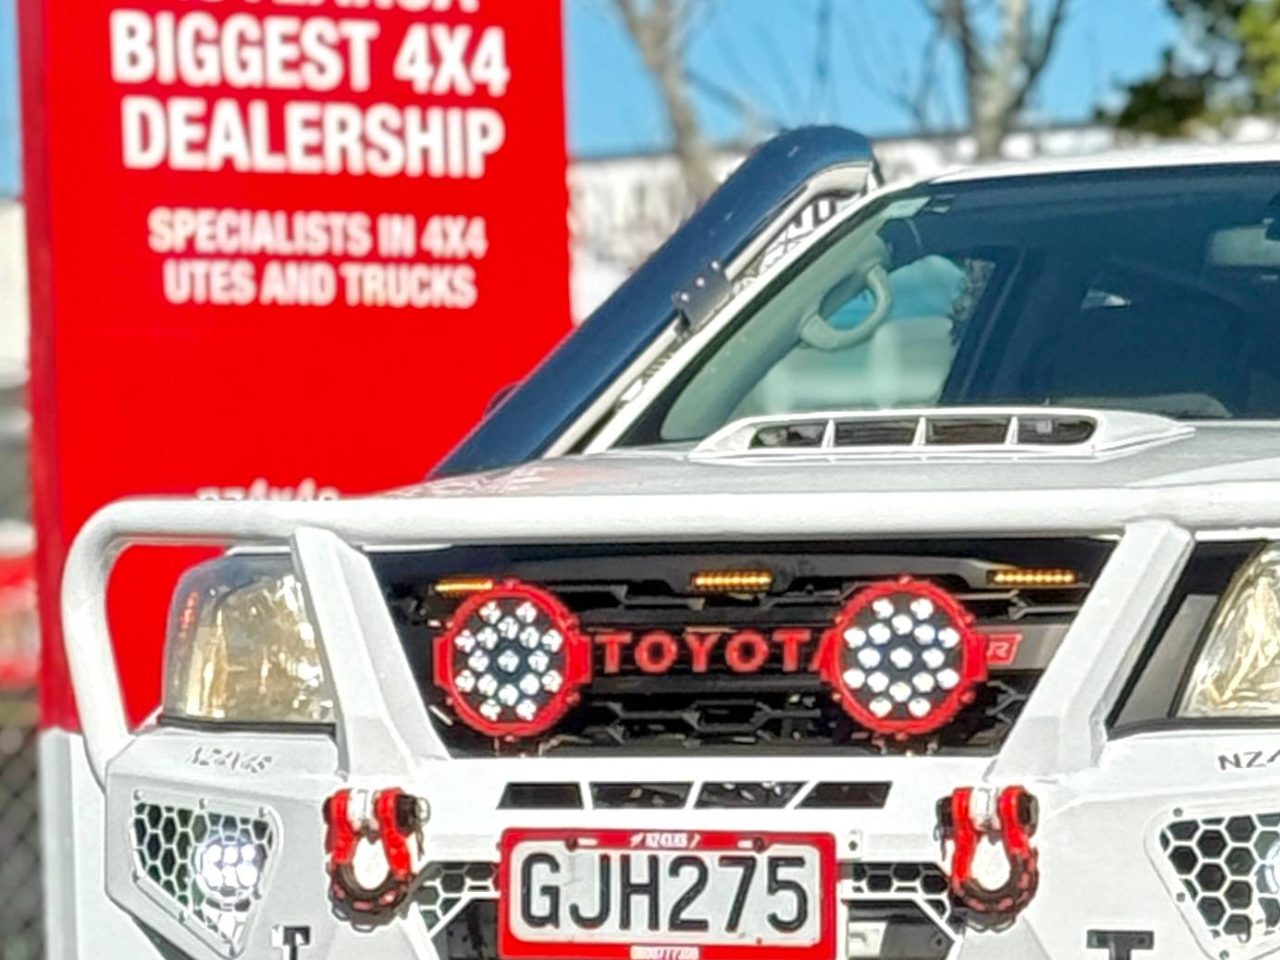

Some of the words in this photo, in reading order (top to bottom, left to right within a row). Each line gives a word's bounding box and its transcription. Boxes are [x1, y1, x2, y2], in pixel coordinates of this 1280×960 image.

[109, 9, 380, 91] BIGGEST
[394, 23, 511, 97] 4X4
[121, 95, 506, 178] DEALERSHIP
[148, 207, 373, 257] SPECIALISTS
[377, 214, 417, 258] IN
[421, 216, 489, 259] 4X4
[163, 259, 257, 305] UTES
[260, 261, 337, 306] AND
[339, 263, 478, 309] TRUCKS
[594, 628, 829, 674] TOYOT
[521, 852, 808, 933] GJH275
